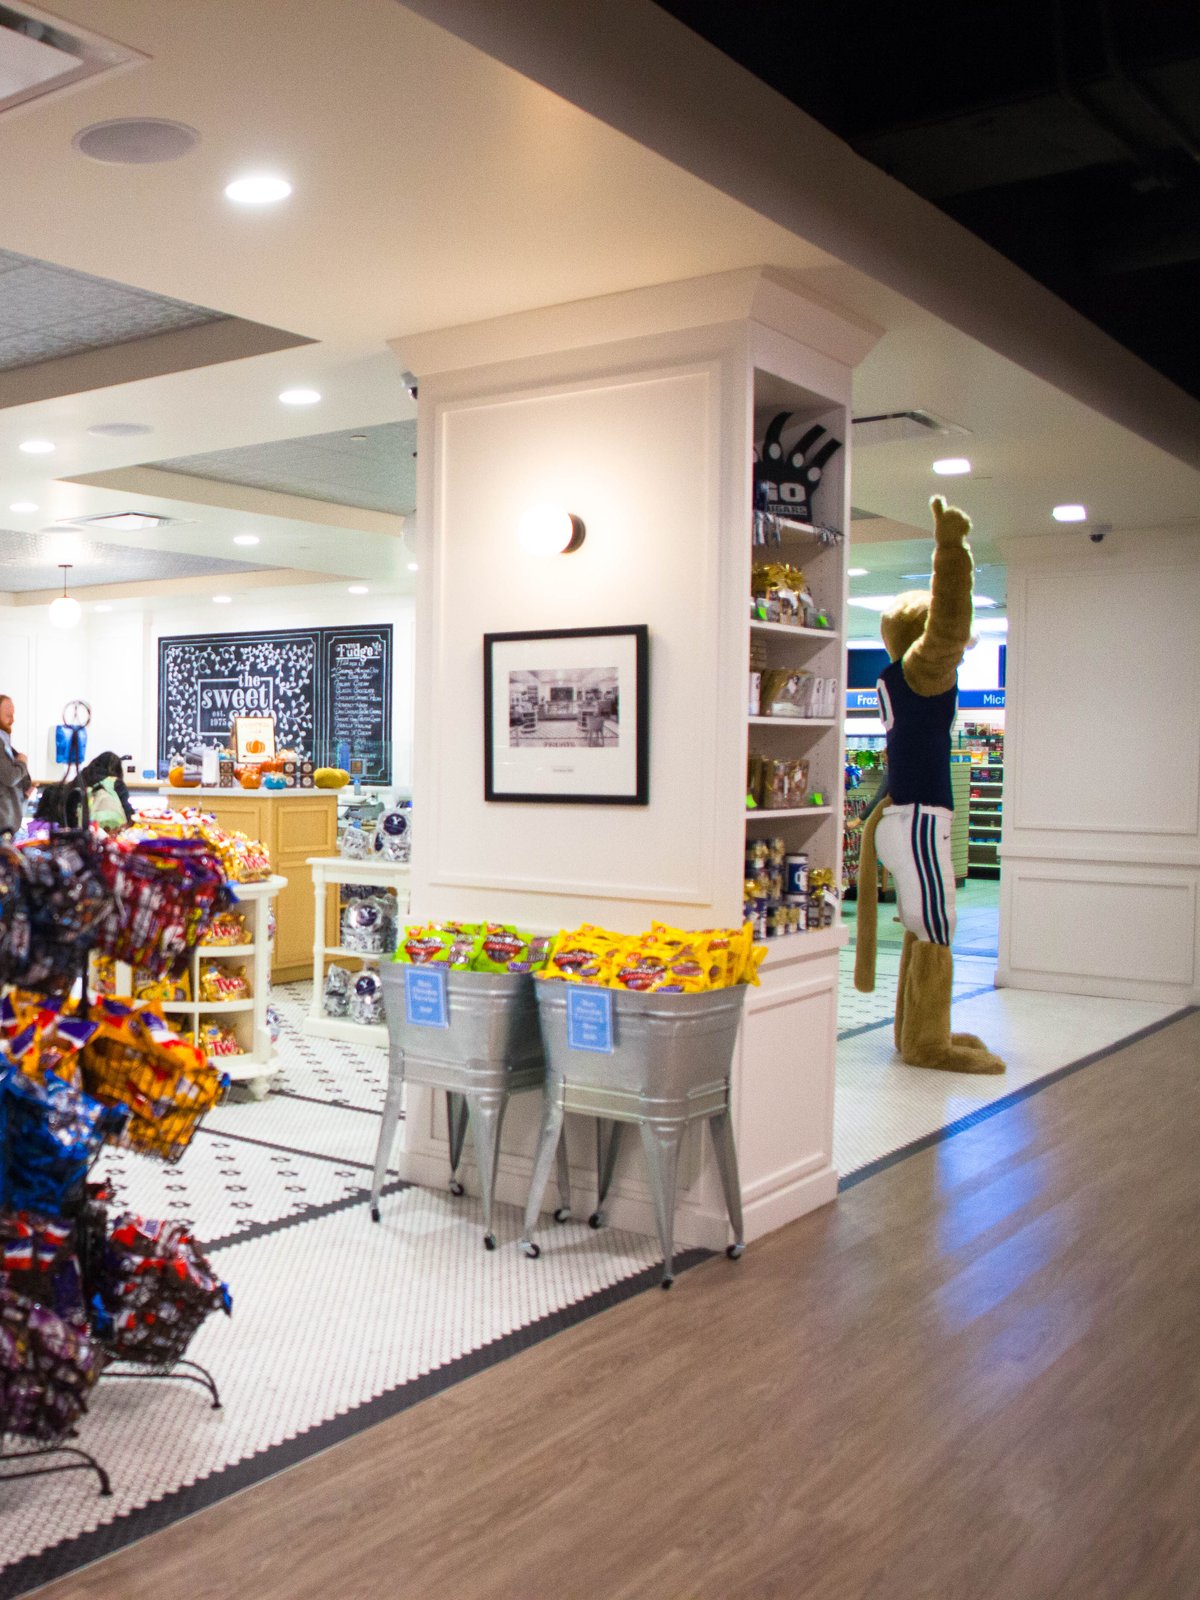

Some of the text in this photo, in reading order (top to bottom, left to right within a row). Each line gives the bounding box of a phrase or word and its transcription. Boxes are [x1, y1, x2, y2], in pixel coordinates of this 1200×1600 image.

[335, 643, 374, 662] Fudge
[238, 672, 260, 687] the
[202, 684, 268, 709] sweet
[210, 718, 227, 727] 1975
